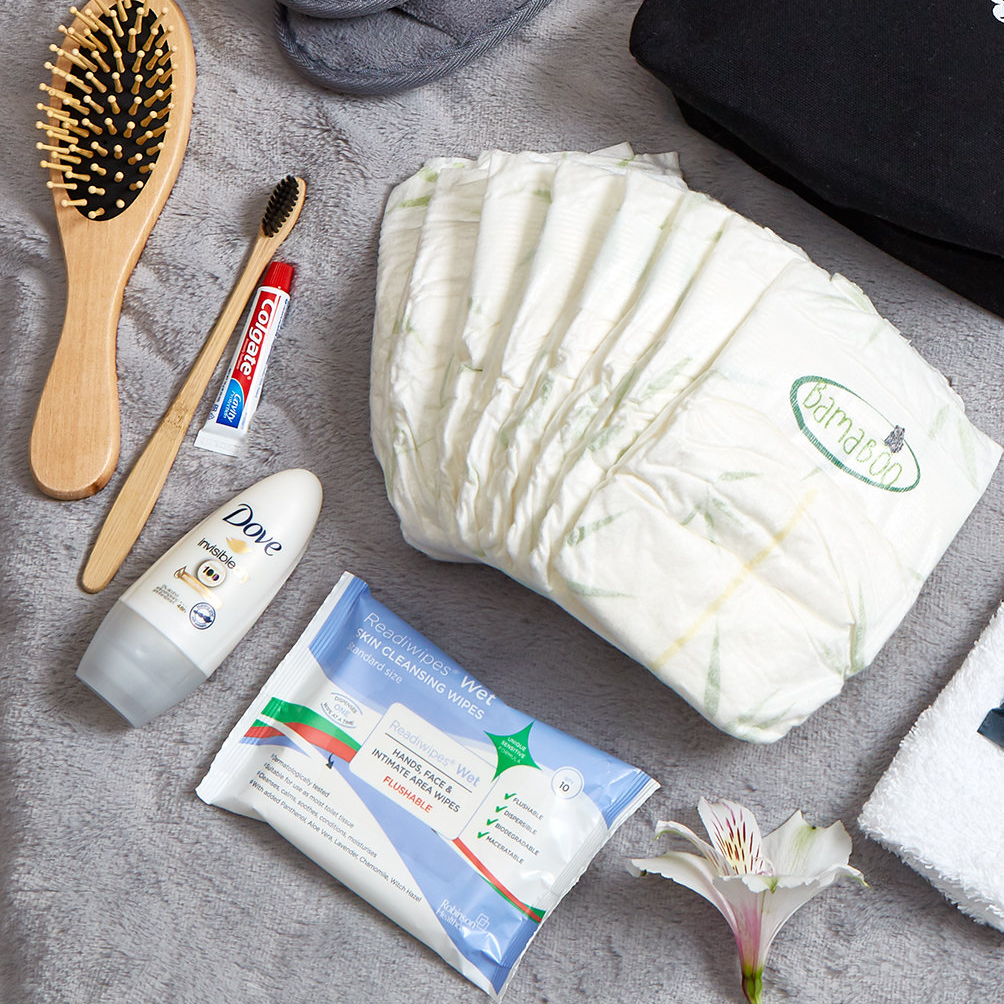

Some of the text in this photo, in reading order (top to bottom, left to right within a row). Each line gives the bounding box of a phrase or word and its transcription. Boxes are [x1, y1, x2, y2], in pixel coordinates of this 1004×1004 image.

[240, 298, 275, 376] Colgate
[229, 393, 242, 423] Cavity
[222, 503, 283, 556] Dove
[197, 537, 236, 570] invisible
[202, 565, 220, 582] 100
[355, 628, 484, 719] SKIN CLEANSING WIPES
[384, 667, 403, 683] size
[333, 696, 357, 713] DISPENSES
[459, 676, 495, 705] Wet
[333, 704, 350, 716] ONE
[497, 746, 521, 763] FORMULA
[500, 740, 525, 758] SENSITIVE
[507, 737, 526, 751] UNIQUE
[371, 749, 459, 812] INTIMATE AREA WIPES
[392, 749, 452, 793] HANDS, FACE &
[454, 764, 480, 786] Wet
[264, 763, 284, 779] Suitable
[283, 776, 293, 785] for
[291, 783, 302, 792] use
[309, 794, 324, 807] moist
[323, 804, 339, 817] toilet
[337, 814, 354, 828] tissue
[312, 783, 329, 797] tested
[382, 776, 432, 812] FLUSHABLE
[559, 782, 569, 791] 10
[503, 810, 538, 834] DISPERSIBLE
[512, 797, 544, 819] FLUSHABLE
[279, 787, 298, 802] calms,
[296, 799, 319, 817] soothes,
[318, 814, 348, 838] conditions,
[347, 834, 377, 858] moisturises
[251, 781, 421, 902] With added Panthenol, Aloe Vera, Lavender, Chamomile, Witch Hazel
[485, 837, 525, 863] MACERATABLE
[493, 823, 540, 855] BIODEGRADABLE
[439, 899, 478, 927] Robinson
